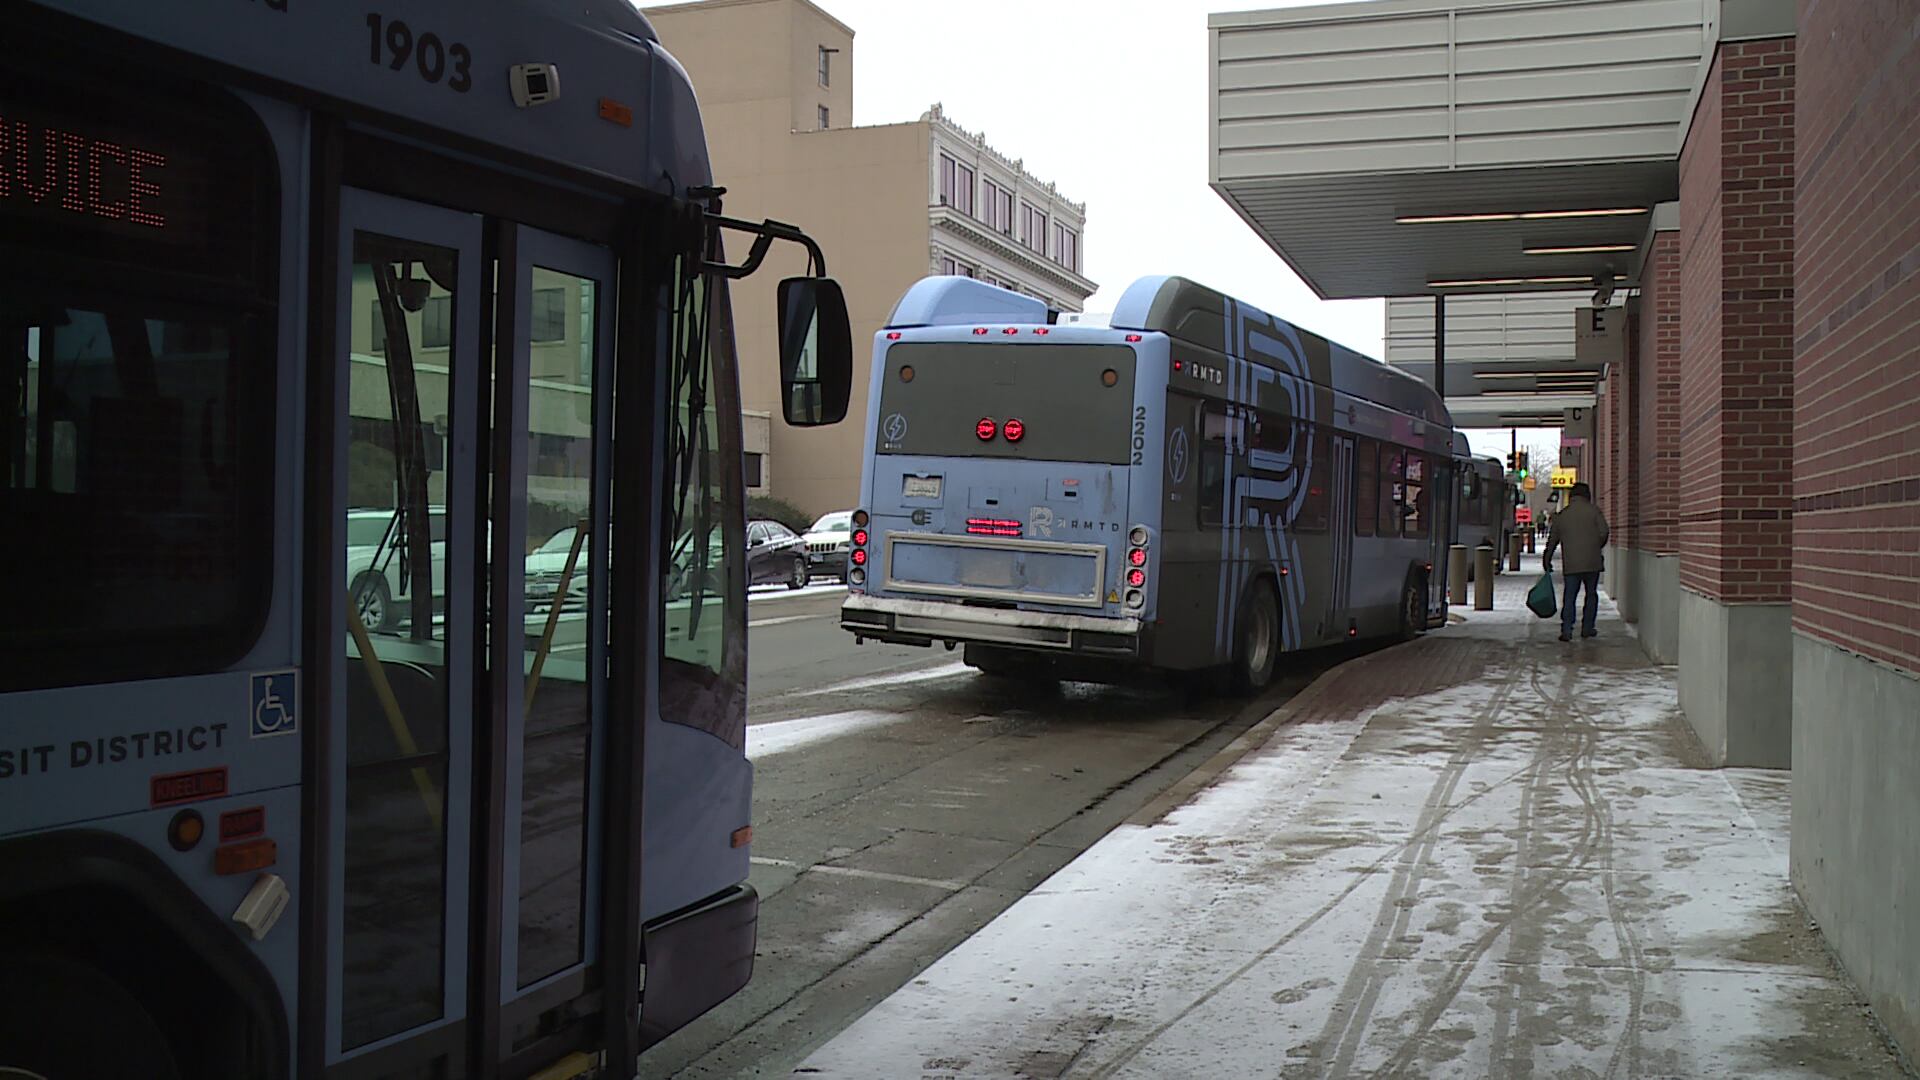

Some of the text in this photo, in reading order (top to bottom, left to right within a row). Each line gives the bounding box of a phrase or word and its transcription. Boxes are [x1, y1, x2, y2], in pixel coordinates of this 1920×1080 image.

[367, 13, 472, 93] 1903
[1593, 308, 1605, 331] E
[1193, 363, 1222, 384] RMTD
[1573, 408, 1582, 421] C
[1132, 406, 1146, 466] 2202
[71, 723, 227, 768] DISTRICT
